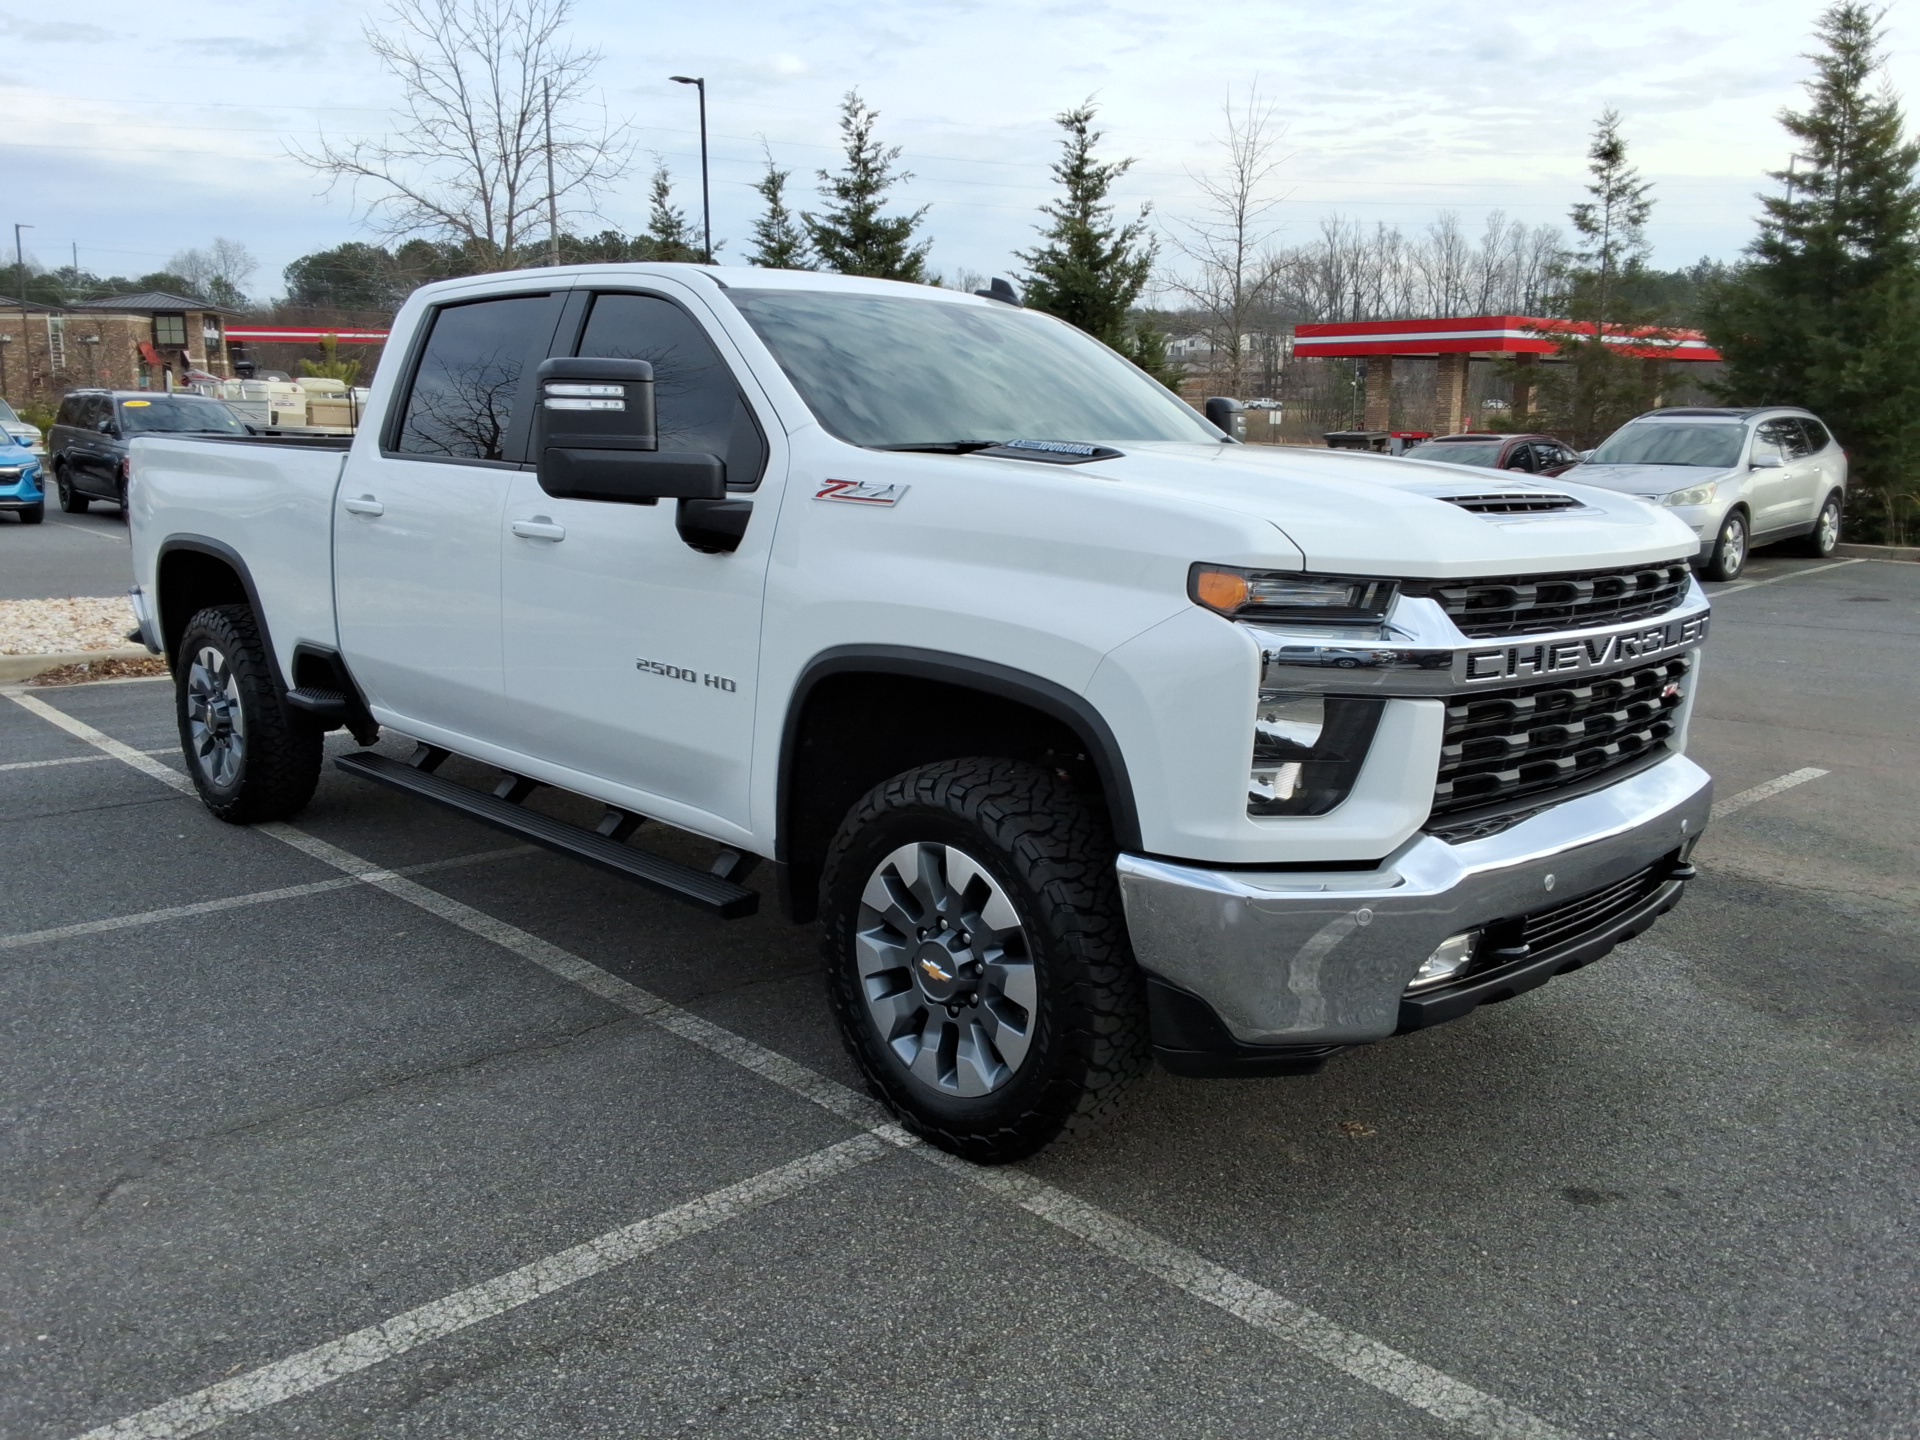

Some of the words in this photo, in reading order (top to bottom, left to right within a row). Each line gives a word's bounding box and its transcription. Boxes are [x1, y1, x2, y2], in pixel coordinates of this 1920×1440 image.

[1039, 442, 1093, 456] DURAMAX
[812, 478, 910, 507] Z71
[1465, 611, 1710, 682] CHEVROLET
[636, 657, 697, 683] 2500
[704, 673, 736, 693] HD
